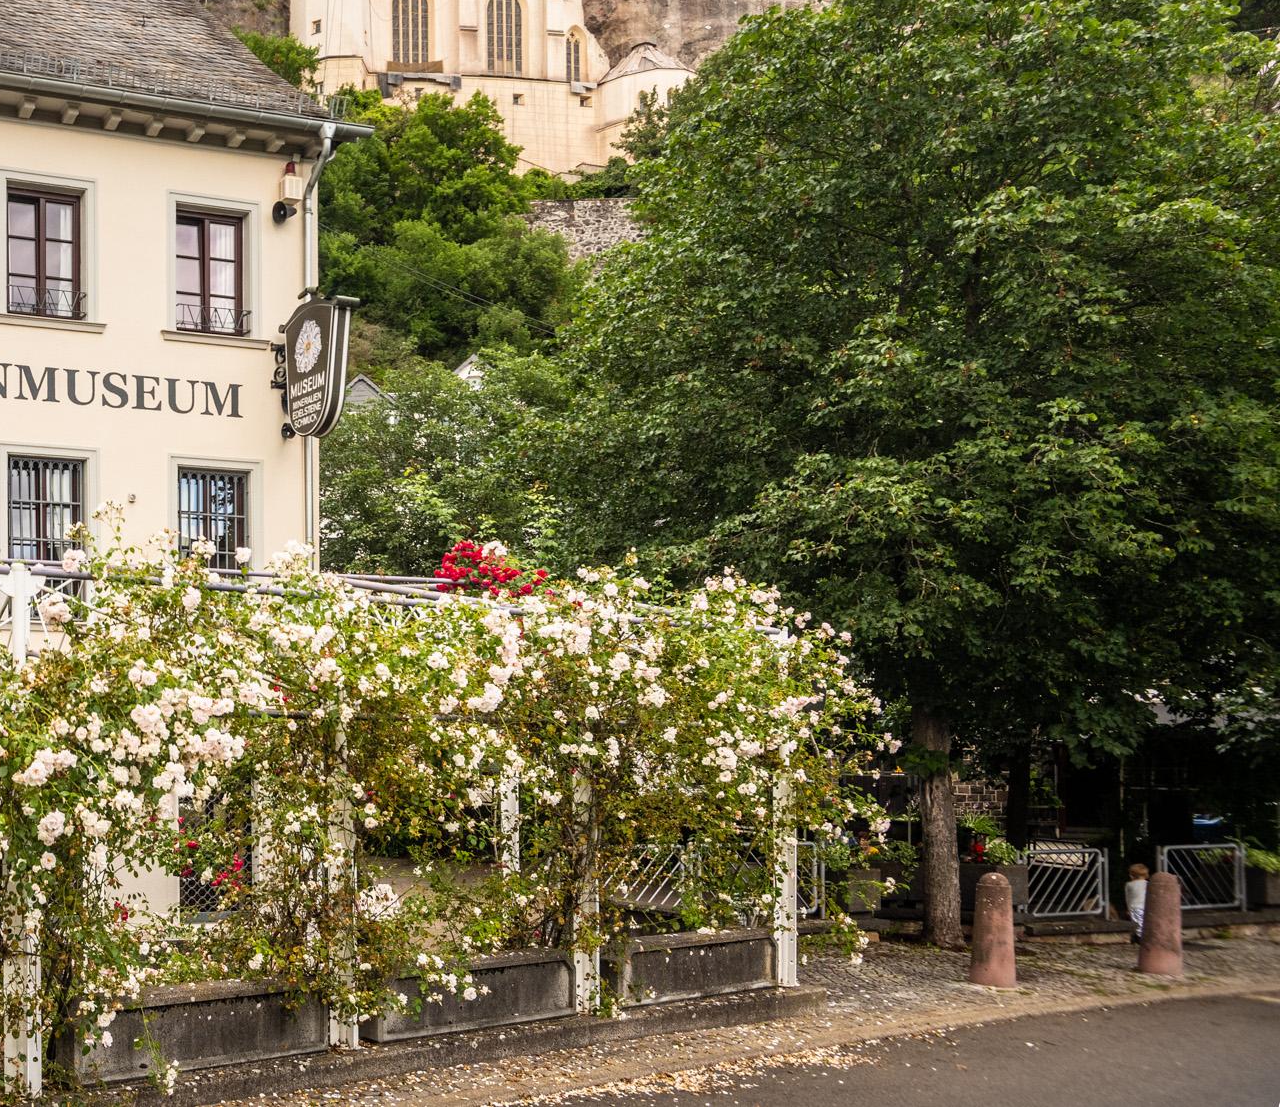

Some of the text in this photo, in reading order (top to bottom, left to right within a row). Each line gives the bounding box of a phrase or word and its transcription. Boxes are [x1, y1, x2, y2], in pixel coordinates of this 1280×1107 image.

[290, 371, 325, 399] MUSEUM
[292, 391, 322, 410] MINERALIEN
[292, 402, 321, 420] EDELSTEINE
[294, 414, 317, 429] SCHMUCK
